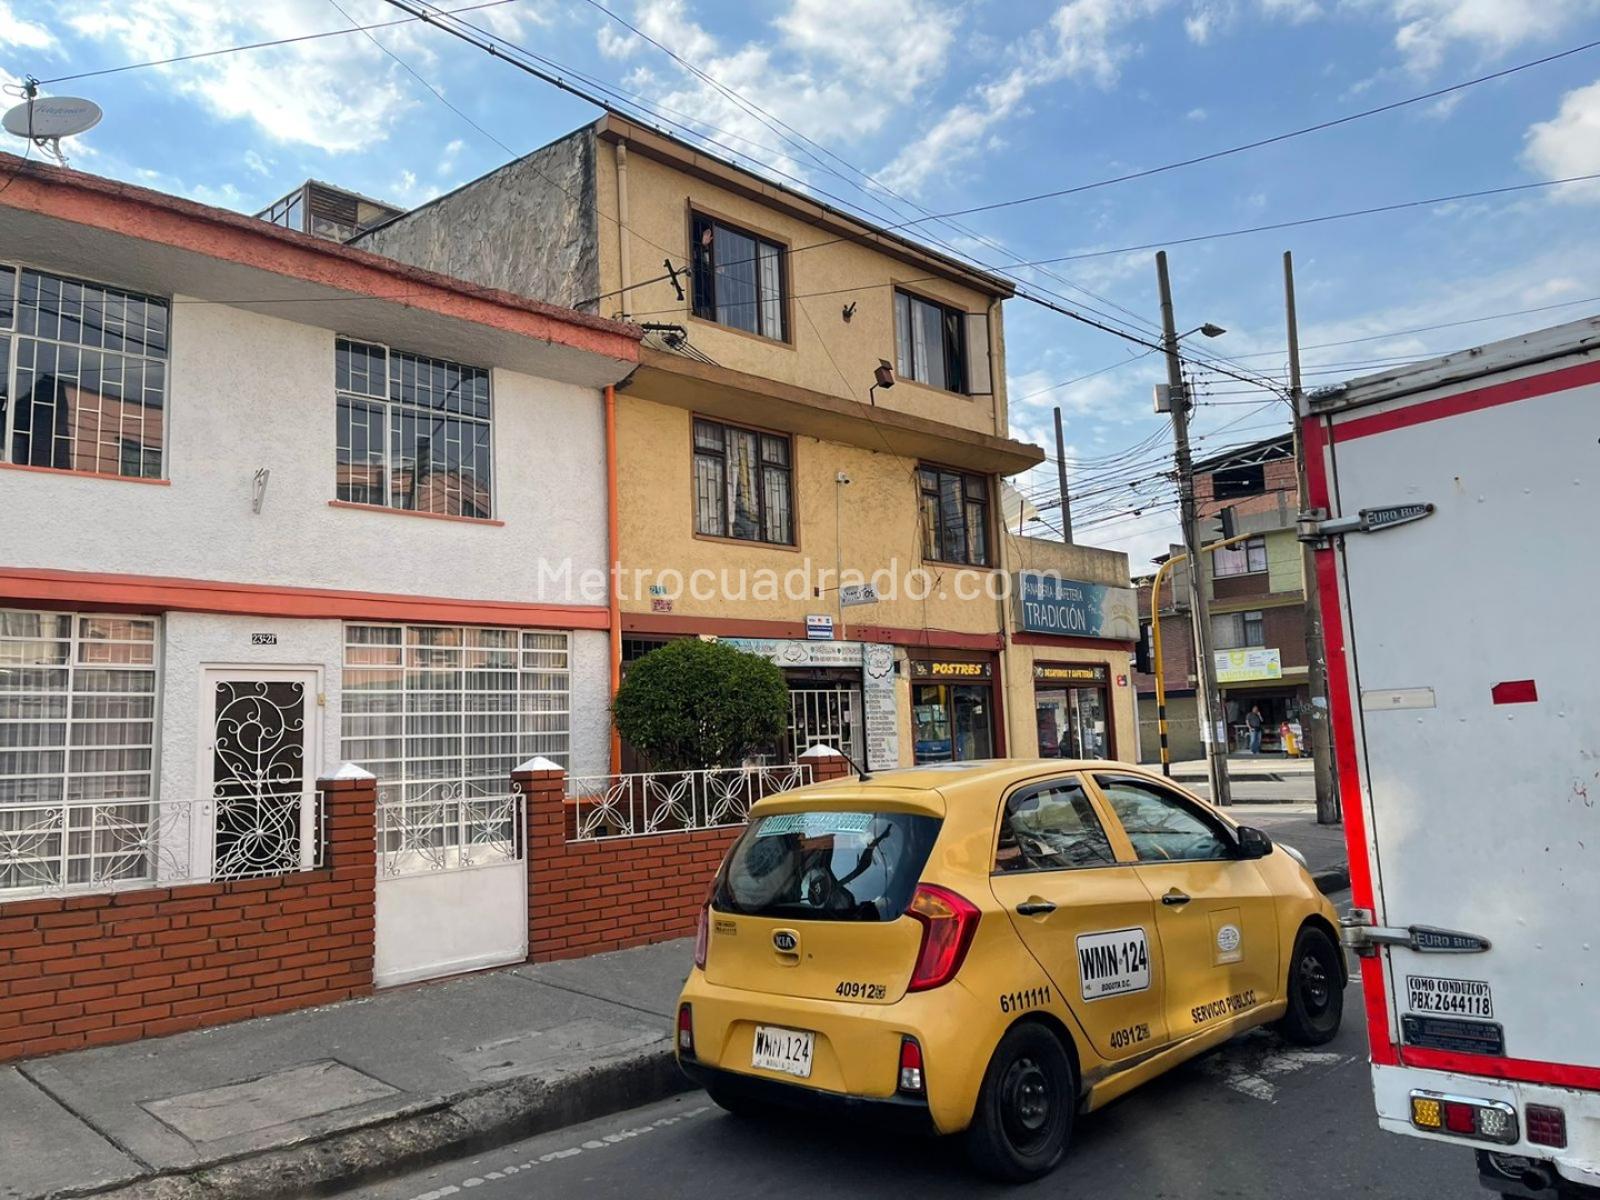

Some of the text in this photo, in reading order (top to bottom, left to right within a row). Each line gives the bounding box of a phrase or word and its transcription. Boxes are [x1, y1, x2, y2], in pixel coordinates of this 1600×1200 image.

[1368, 511, 1398, 524] EURO
[1025, 602, 1086, 631] TRADICIÓN
[932, 663, 982, 675] POSTRES
[776, 935, 792, 947] KIA
[1417, 932, 1449, 946] EURO
[836, 982, 875, 999] 40912
[1410, 978, 1488, 996] COMO CONDUZCO?
[1000, 985, 1051, 1013] 6111111
[1191, 999, 1227, 1023] SERVICIO
[1110, 1024, 1143, 1048] 40912
